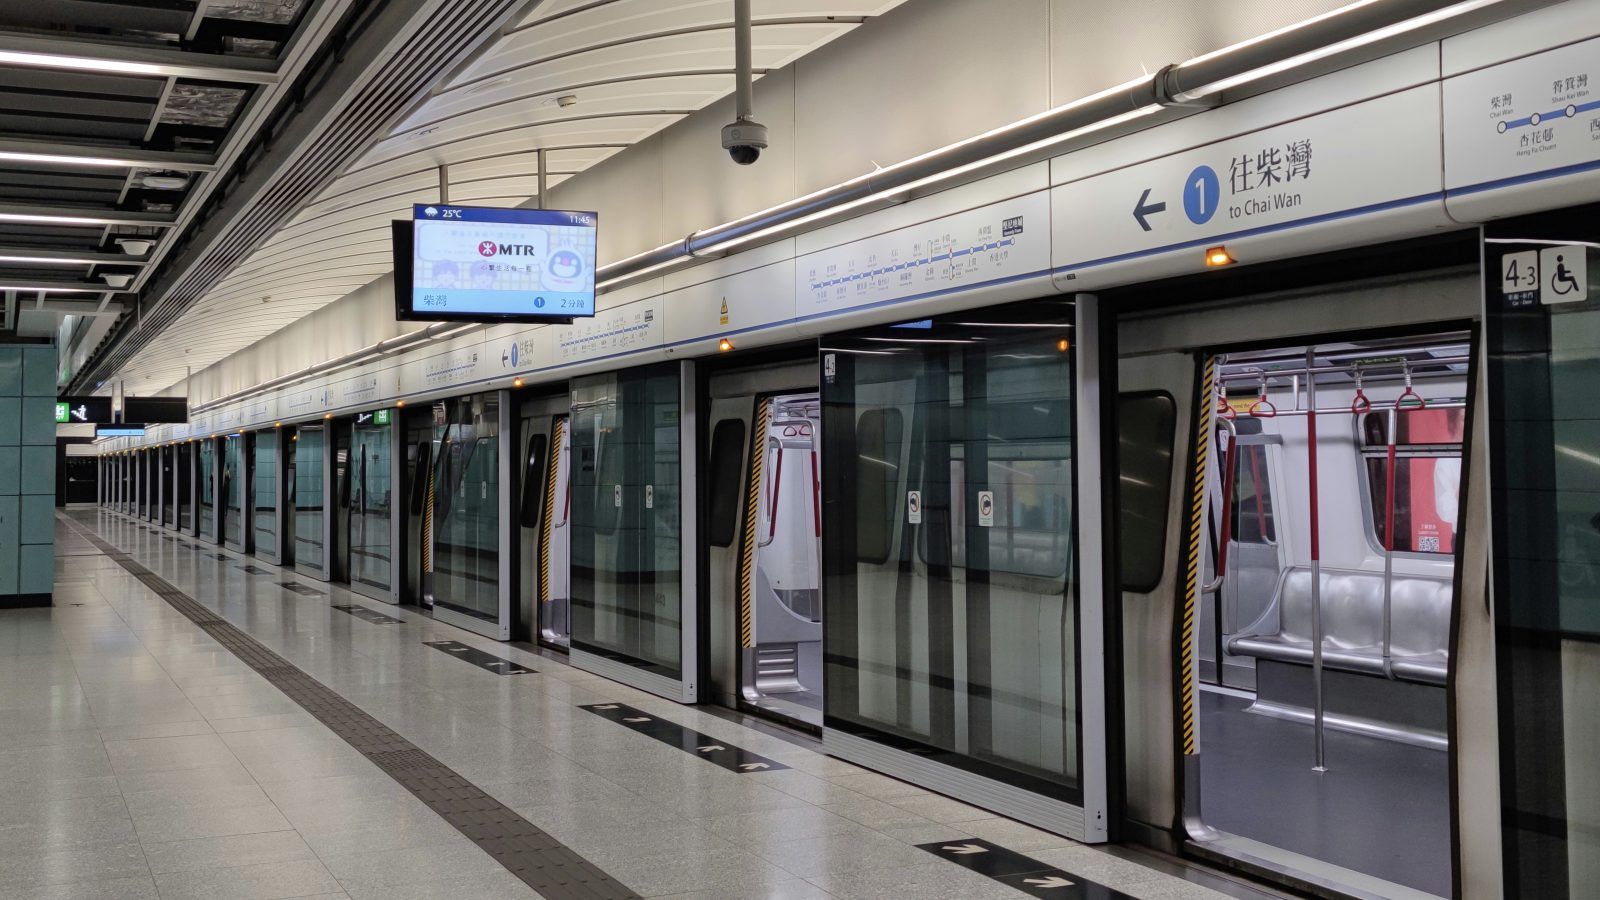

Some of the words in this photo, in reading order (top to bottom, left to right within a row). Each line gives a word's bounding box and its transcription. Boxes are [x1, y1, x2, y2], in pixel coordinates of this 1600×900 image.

[1228, 138, 1313, 195] 往柴灣
[1195, 178, 1205, 215] 1
[1229, 205, 1241, 219] to
[1244, 195, 1271, 215] Chai
[1274, 192, 1301, 208] Wan
[570, 215, 590, 224] 11:45
[499, 244, 535, 256] MTR
[1506, 259, 1536, 287] 4-3
